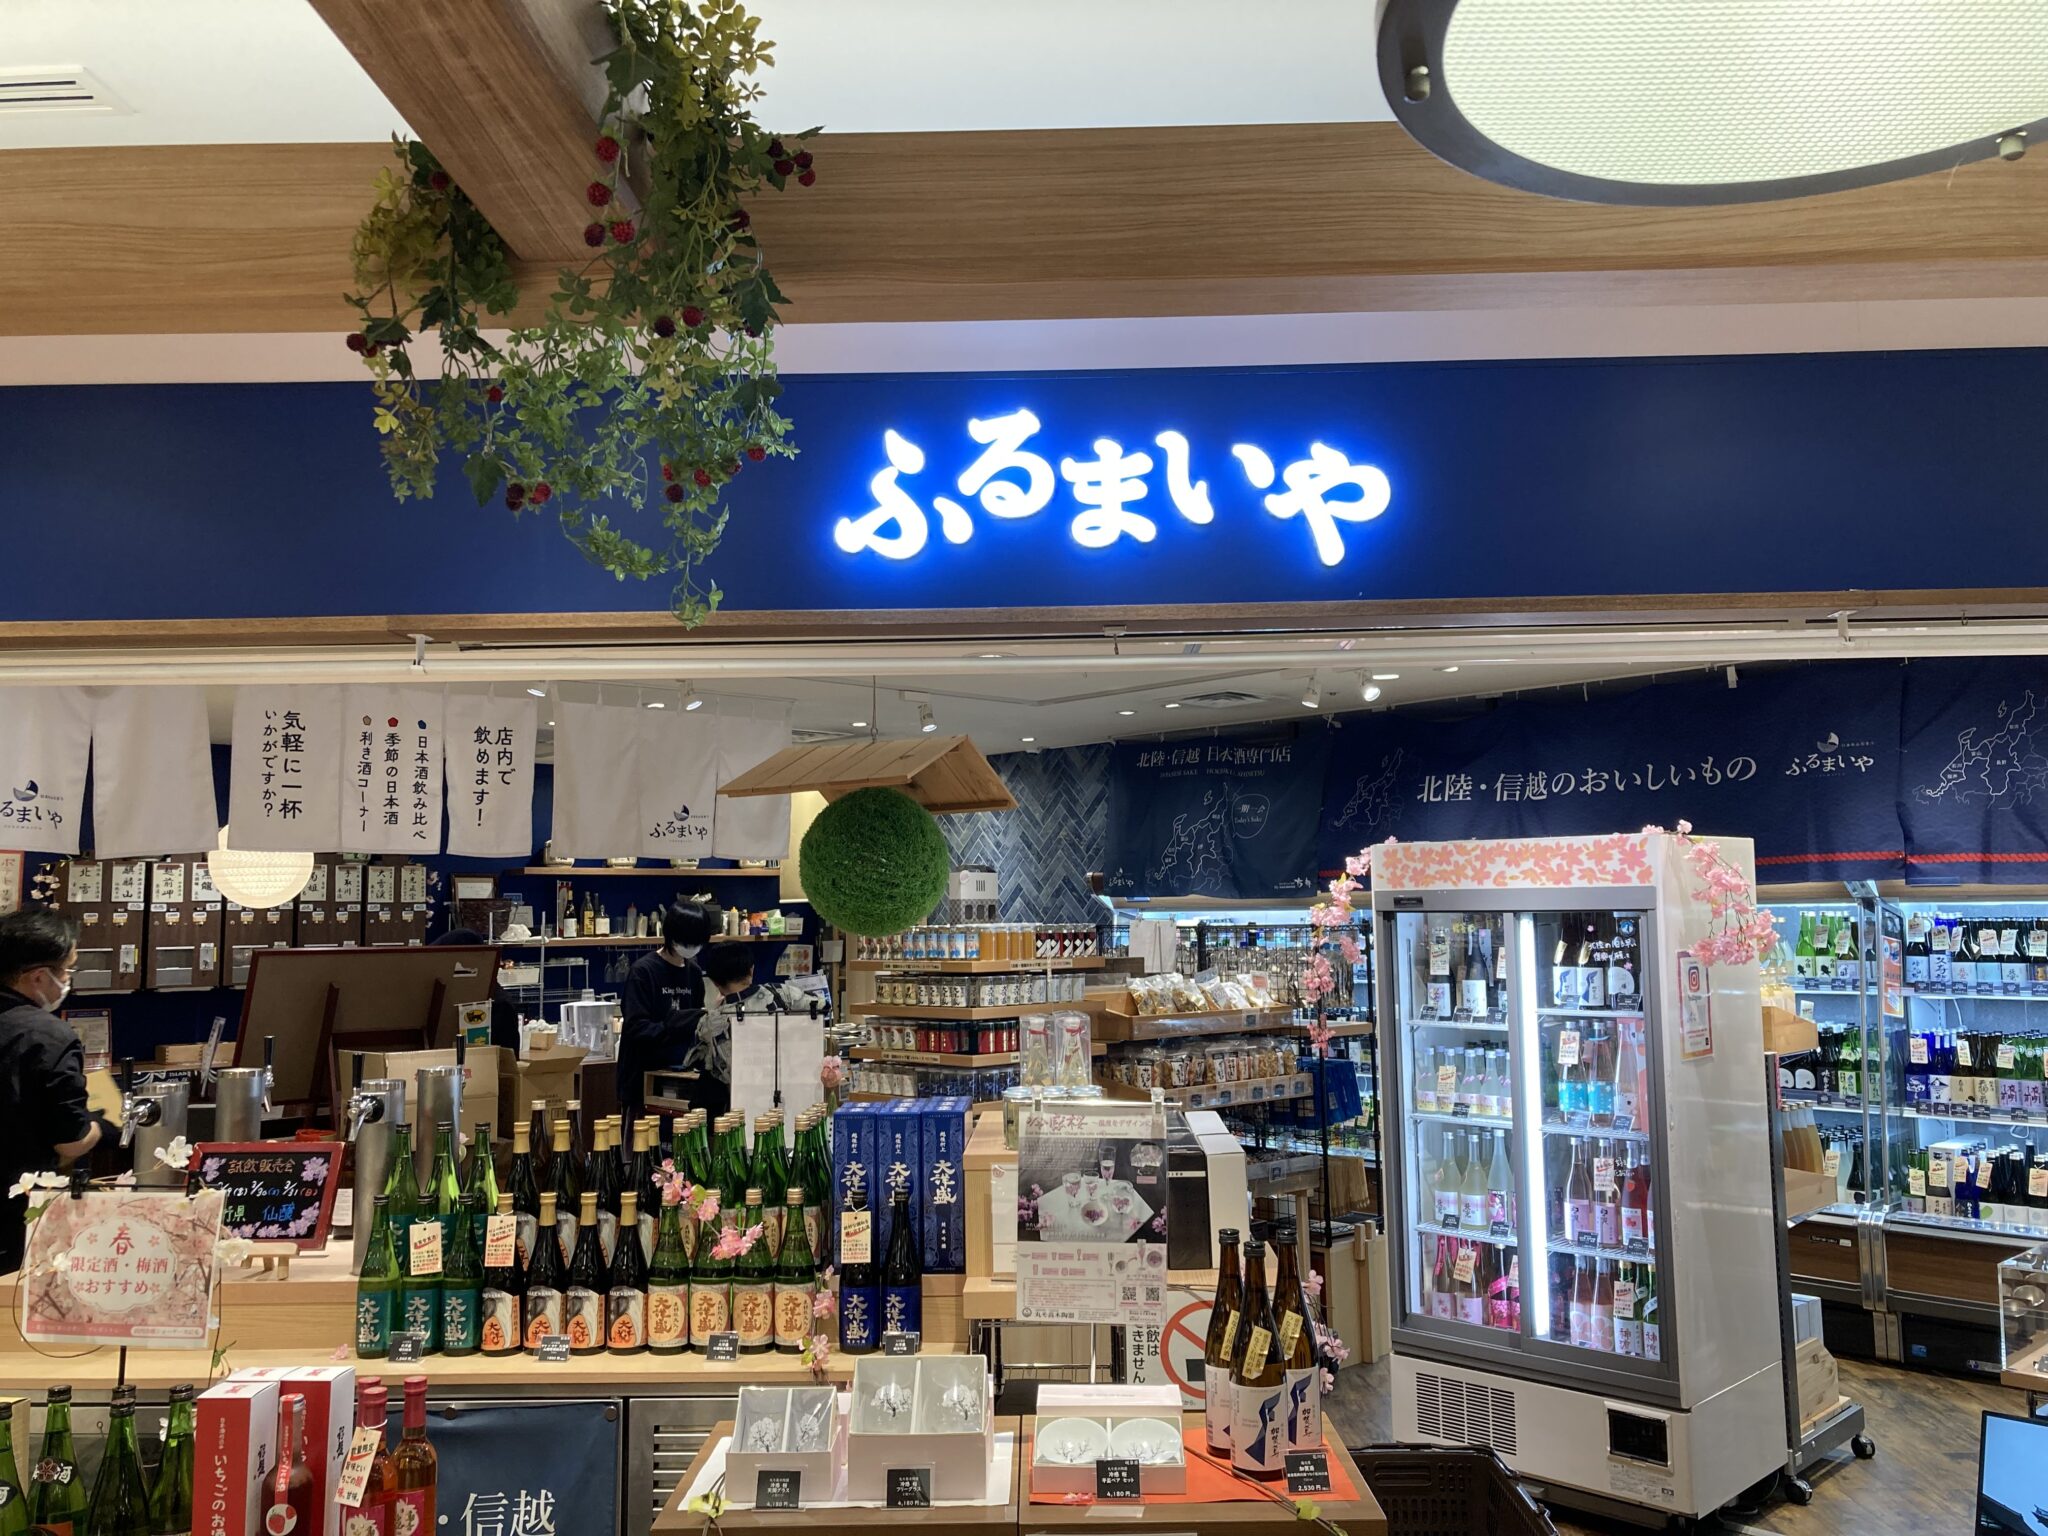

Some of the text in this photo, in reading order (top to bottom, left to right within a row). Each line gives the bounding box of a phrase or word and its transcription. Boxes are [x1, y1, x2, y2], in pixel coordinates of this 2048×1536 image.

[835, 409, 1390, 566] ふるまいや
[260, 708, 279, 818] いかがですか？
[278, 710, 306, 821] 気軽に一杯
[383, 731, 401, 826] 季節の日本酒
[494, 726, 514, 787] 店内で
[1785, 753, 1874, 775] ふるまいや
[356, 730, 374, 833] 利き酒コーナー
[412, 735, 429, 841] 日本酒飲み比べ
[1417, 755, 1757, 803] 北陸・信越のおいしいもの
[649, 821, 708, 840] ふるまいや
[227, 1158, 296, 1175] 試飲販売会
[930, 1160, 957, 1205] 大洋盛
[109, 1222, 134, 1255] 春
[69, 1256, 169, 1275] 限定酒・梅酒
[84, 1279, 149, 1294] おすすめ
[358, 1298, 380, 1342] 大洋盛
[444, 1296, 467, 1340] 大洋盛
[652, 1297, 672, 1335] 大洋盛
[696, 1296, 716, 1332] 大洋盛
[741, 1295, 762, 1333] 大洋盛
[782, 1295, 802, 1332] 大洋盛
[844, 1294, 869, 1339] 大洋盛
[1132, 1324, 1146, 1385] きません
[1146, 1323, 1160, 1357] 飲は
